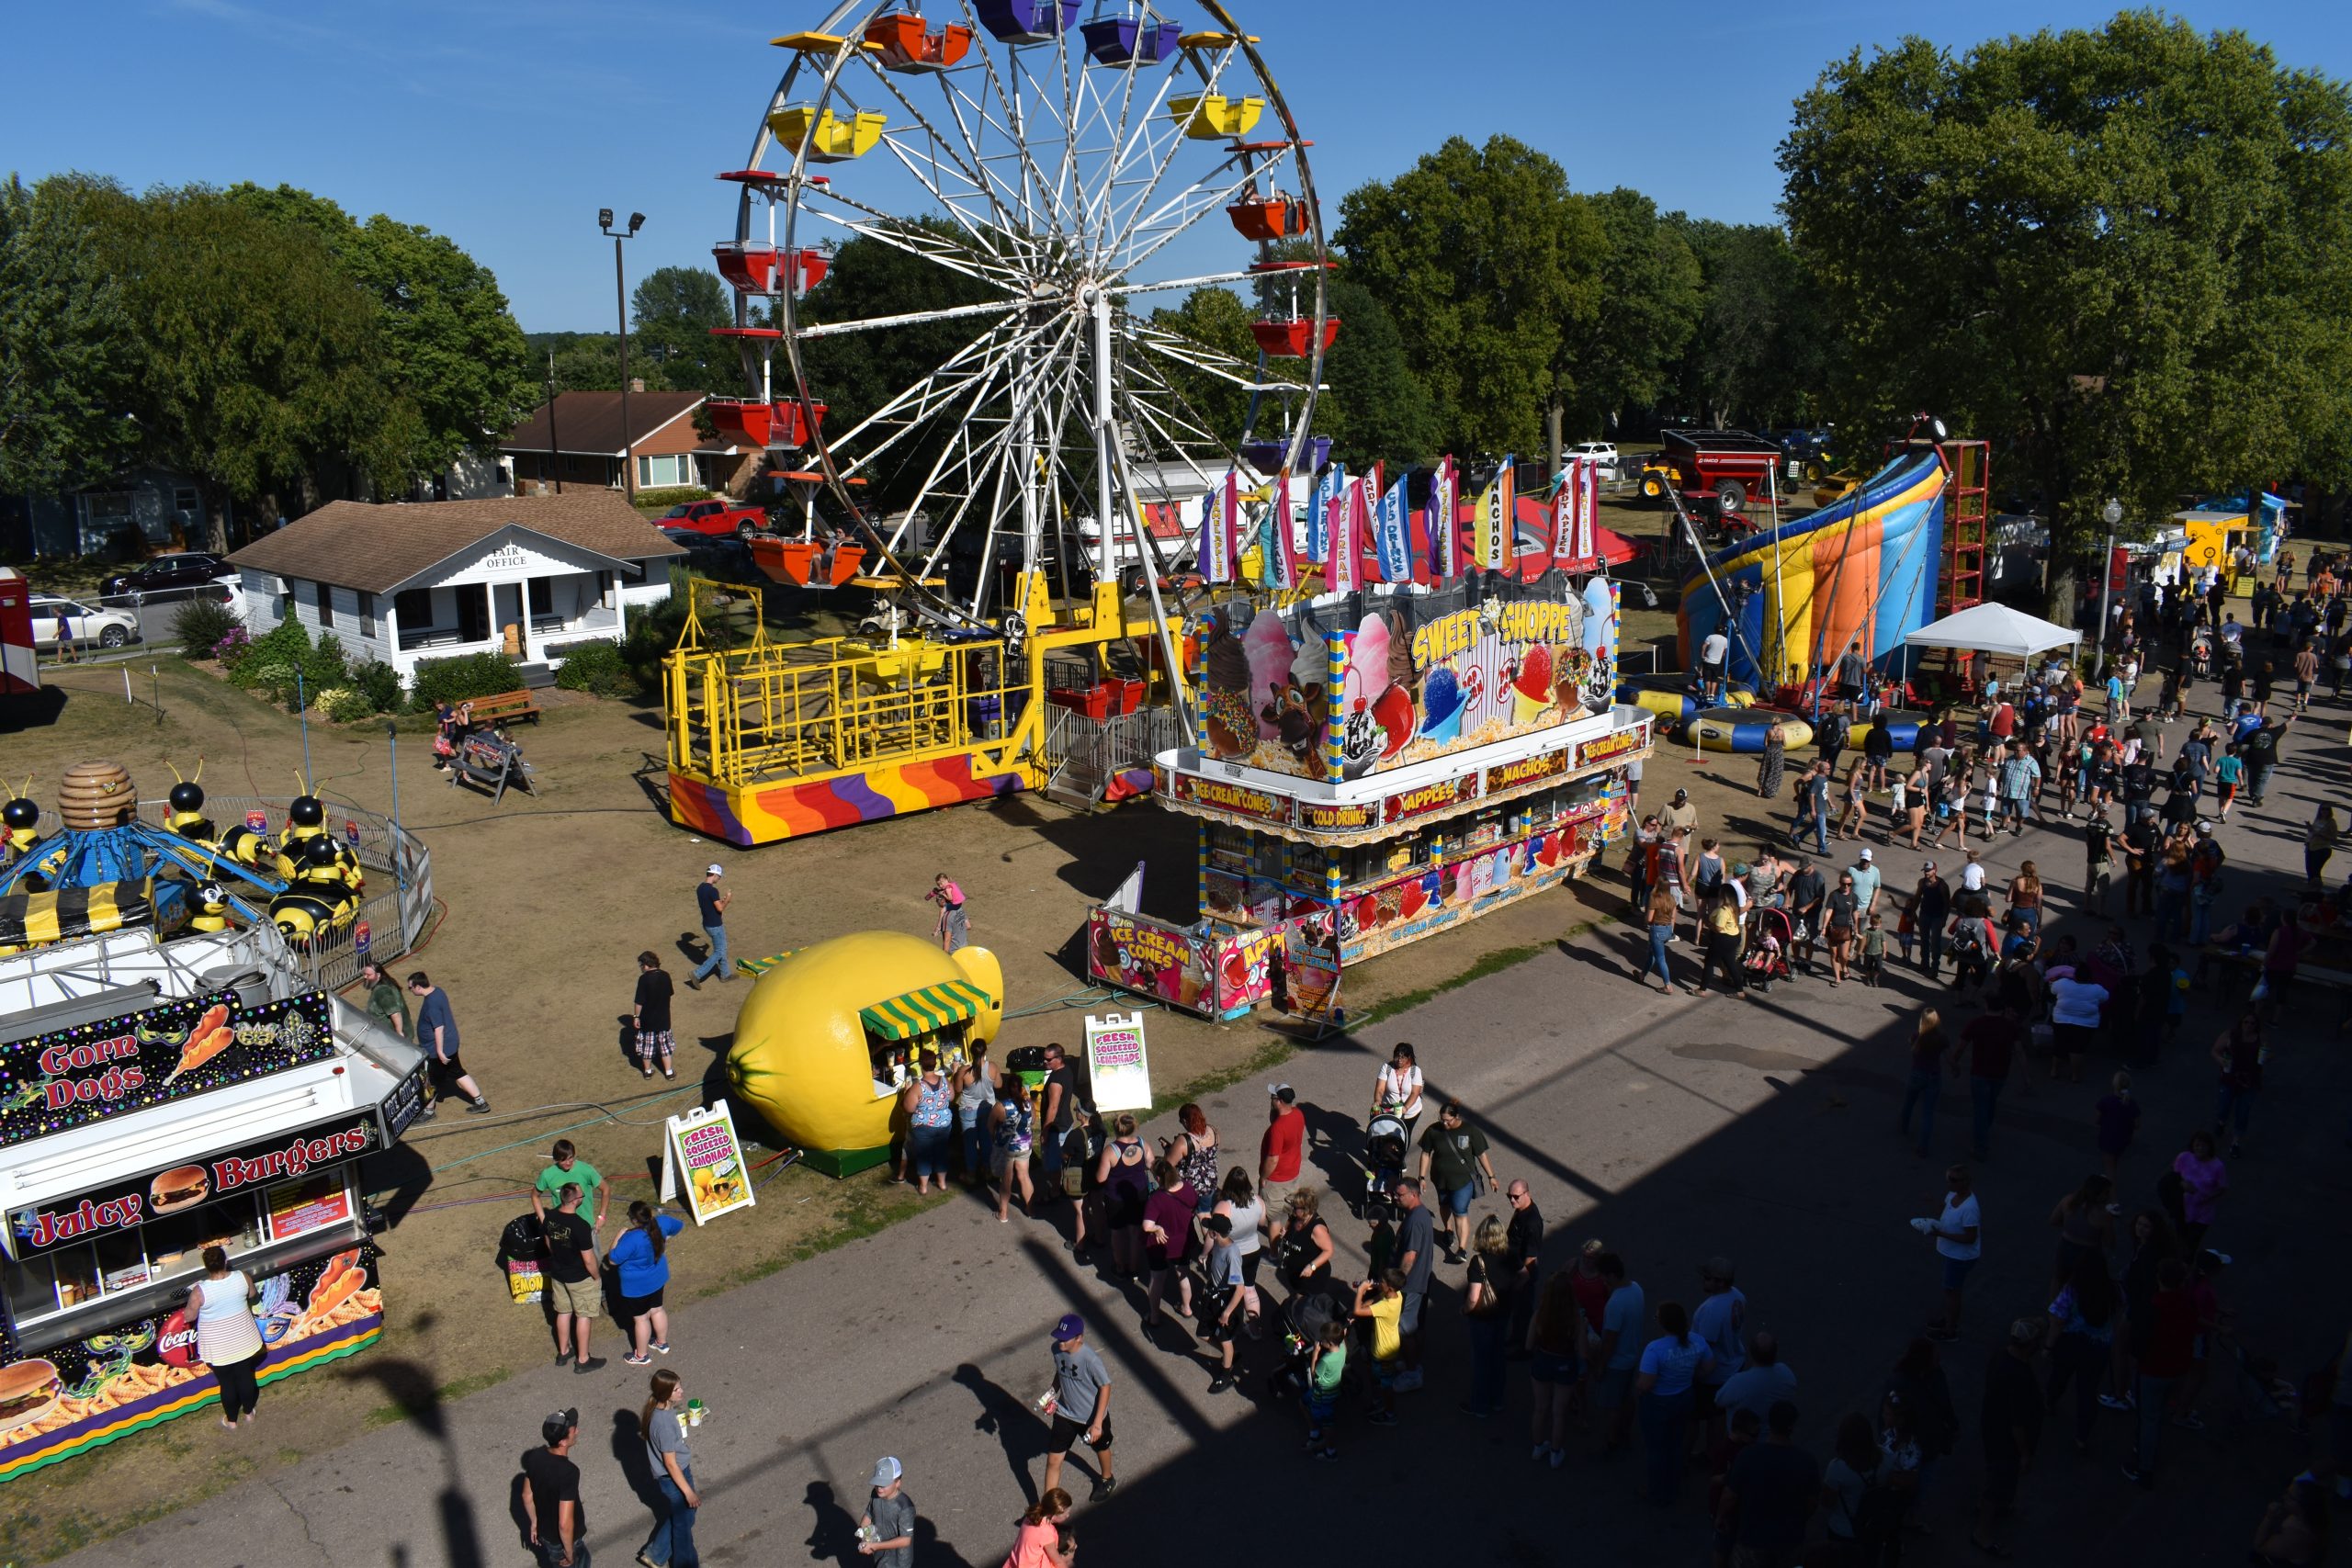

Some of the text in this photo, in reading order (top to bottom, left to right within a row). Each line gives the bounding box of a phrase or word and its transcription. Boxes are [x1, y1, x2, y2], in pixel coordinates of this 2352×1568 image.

[1490, 480, 1500, 560] NACHOS
[1558, 513, 1570, 554] APPLES
[492, 547, 519, 557] FAIR
[1214, 535, 1223, 577] APPLES
[1338, 529, 1350, 581] CREAM
[1387, 525, 1403, 572] DRINKS
[487, 557, 526, 568] OFFICE
[1411, 601, 1571, 671] SWEET SHOPPE
[1586, 732, 1634, 759] ICE CREAM CONES
[1504, 757, 1550, 783] NACHOS
[1195, 782, 1272, 815] ICE CREAM CONES
[1406, 783, 1455, 811] APPLES
[1313, 808, 1367, 827] COLD DRINKS
[1402, 921, 1427, 939] CREAM
[1110, 927, 1134, 944] ICE
[1136, 929, 1191, 964] CREAM
[1127, 942, 1172, 968] CONES
[1289, 953, 1338, 971] ICE CREAM
[1095, 1043, 1139, 1054] SQUEEZED
[1096, 1032, 1135, 1044] FRESH
[40, 1034, 140, 1076] Corn
[1096, 1053, 1140, 1065] LEMONADE
[45, 1065, 146, 1111] Dogs
[385, 1092, 401, 1121] ICE
[392, 1094, 421, 1137] DRINKS
[684, 1125, 724, 1146] FRESH
[685, 1134, 729, 1156] SQUEEZED
[688, 1145, 733, 1168] LEMONADE
[31, 1126, 366, 1247] Juicy Burgers
